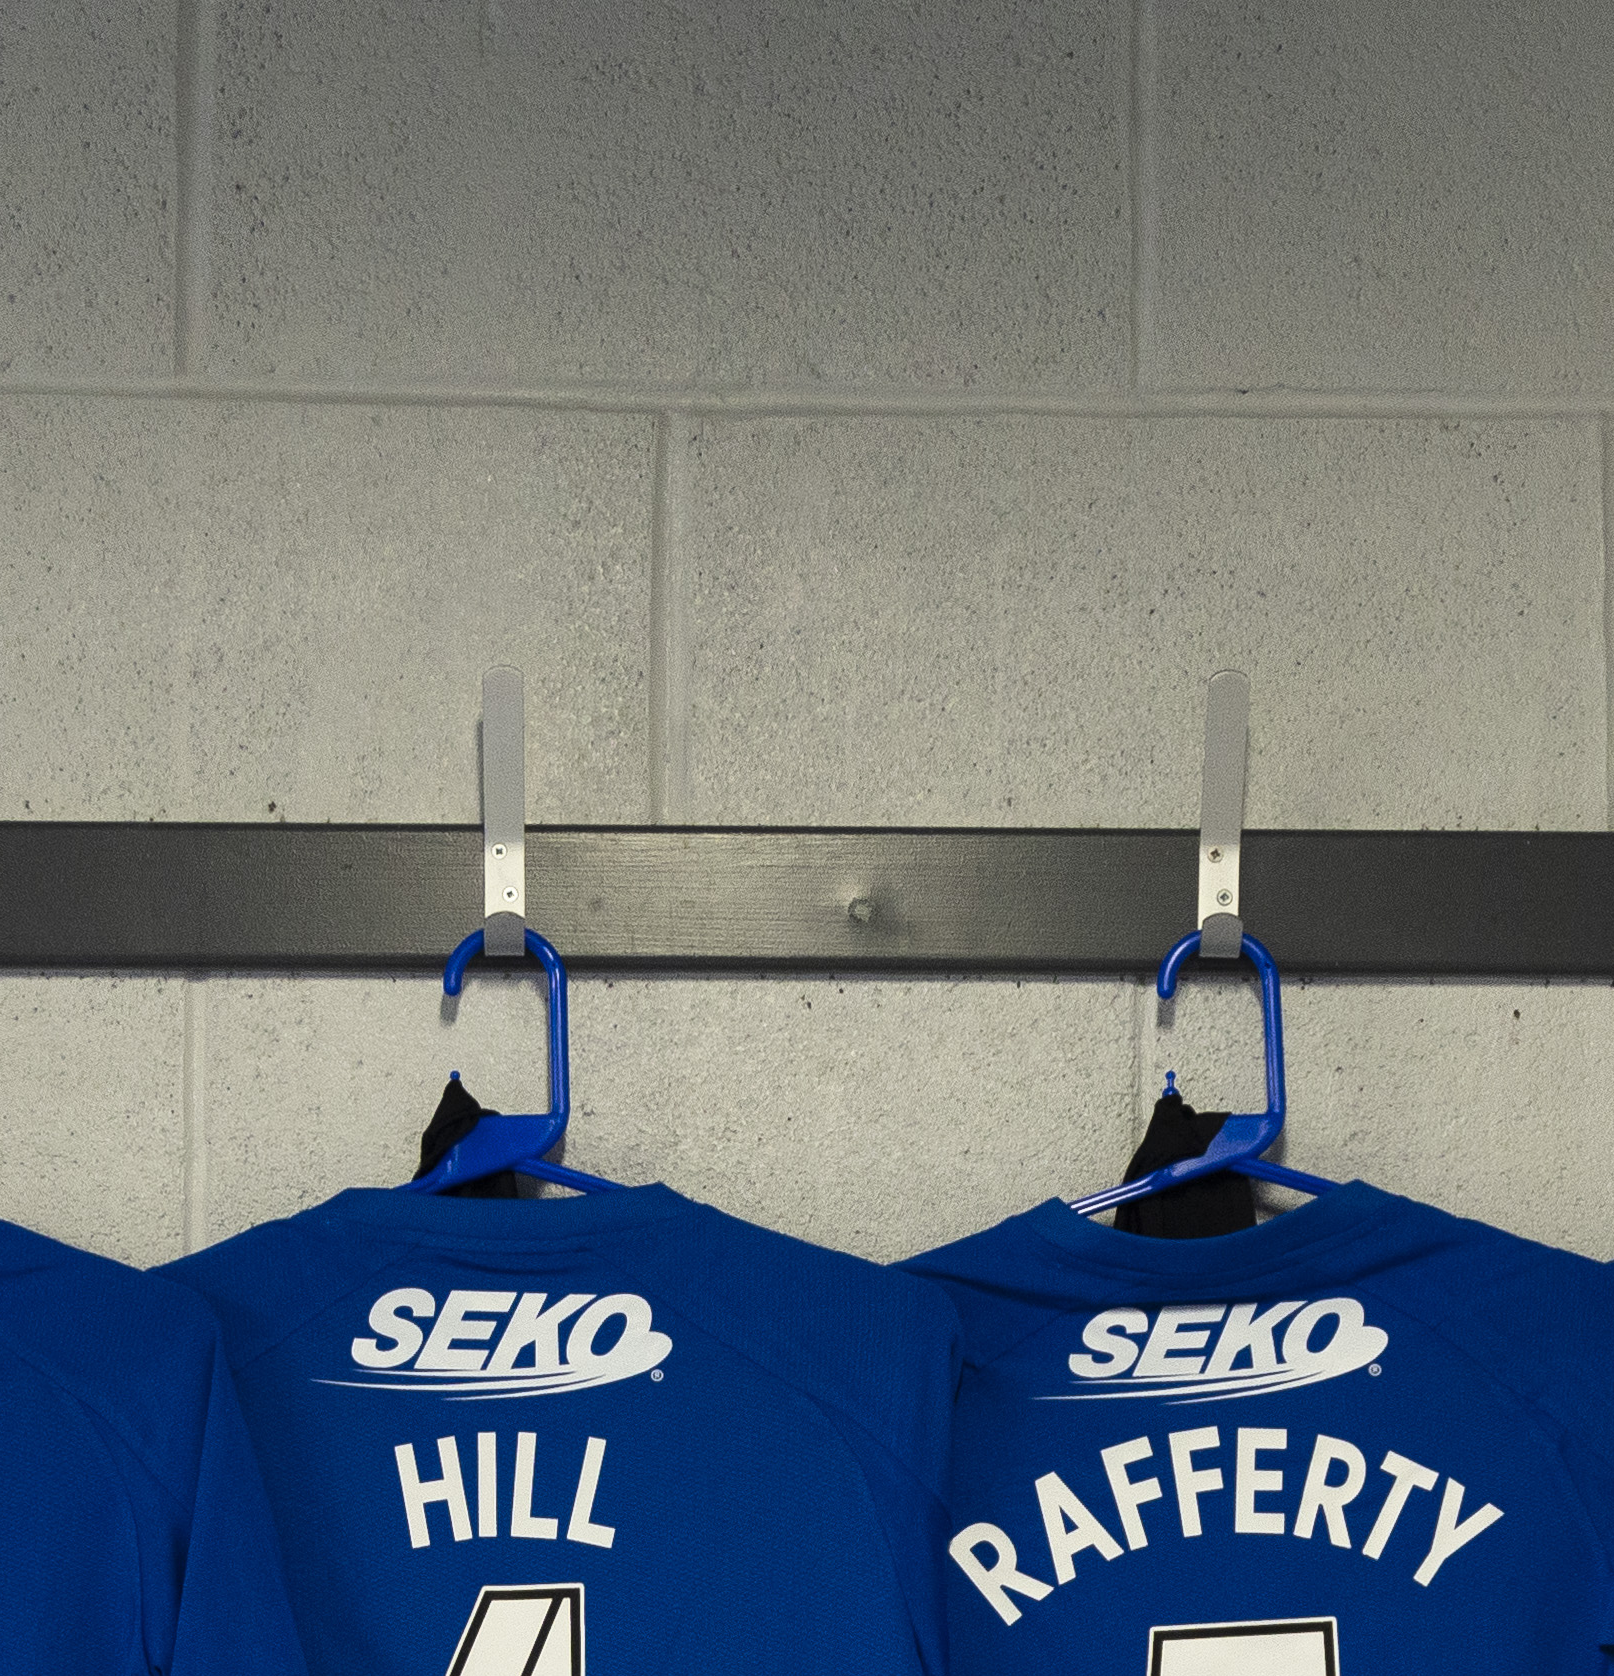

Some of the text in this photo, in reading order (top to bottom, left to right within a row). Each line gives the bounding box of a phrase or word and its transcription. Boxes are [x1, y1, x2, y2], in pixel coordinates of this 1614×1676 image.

[351, 1287, 655, 1372] SEKO
[1068, 1296, 1367, 1379] SEKO
[393, 1431, 616, 1550] HILL
[948, 1425, 1505, 1627] RAFFERTY
